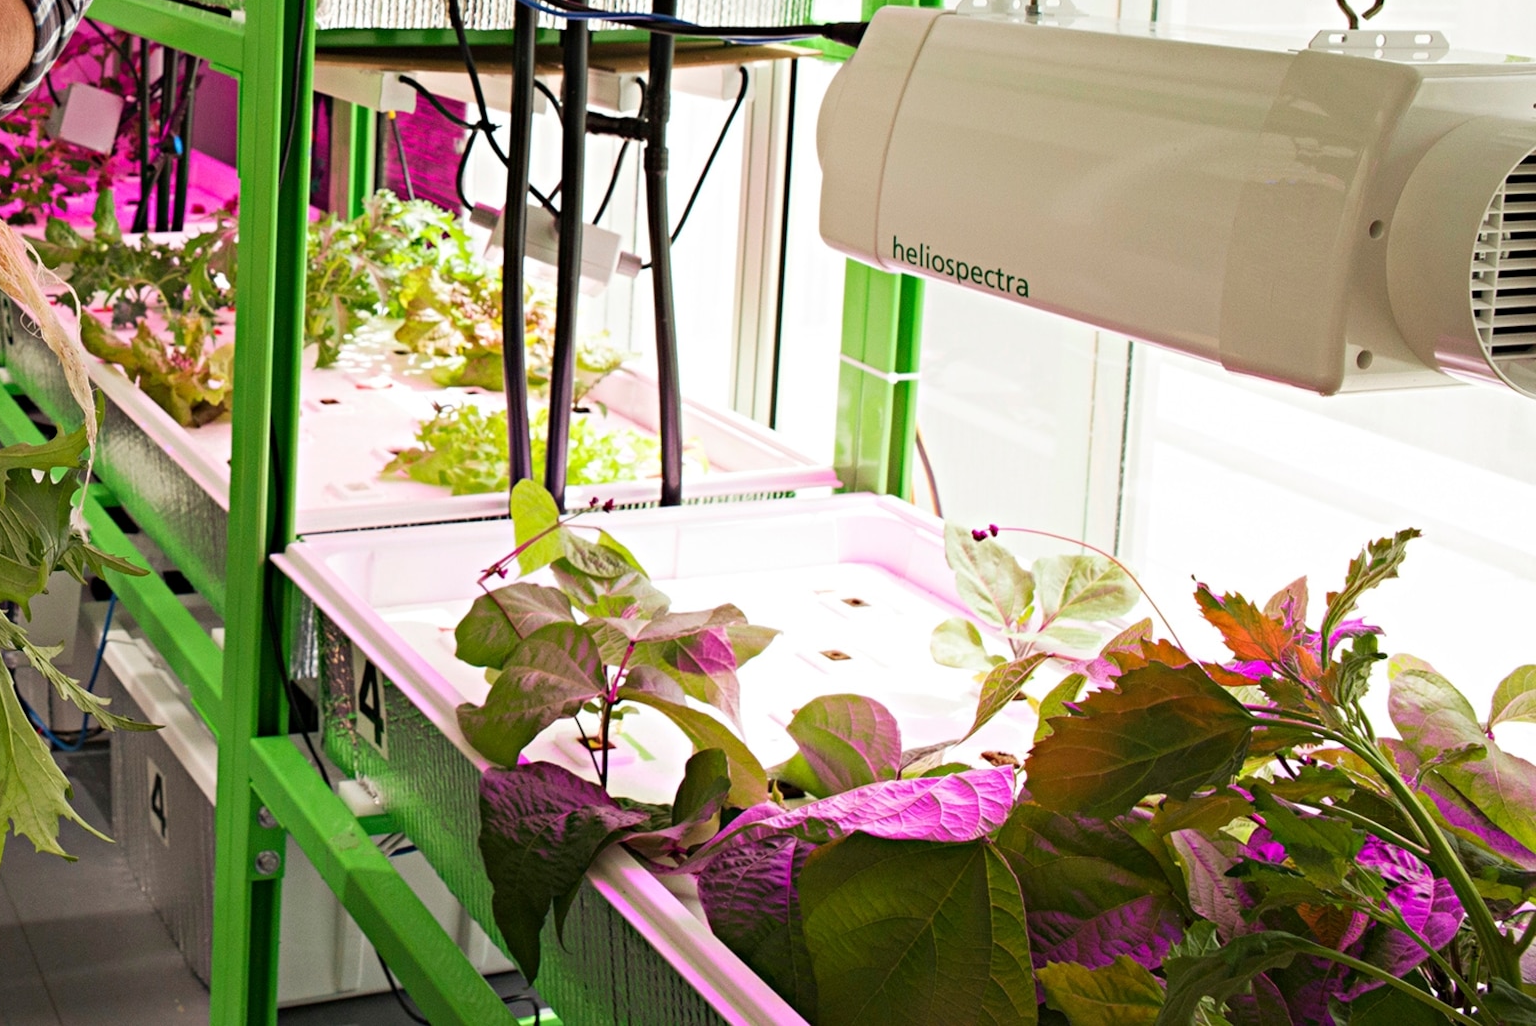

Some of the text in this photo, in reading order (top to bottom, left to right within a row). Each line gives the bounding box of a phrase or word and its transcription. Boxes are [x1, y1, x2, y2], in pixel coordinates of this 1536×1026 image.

[893, 235, 1029, 298] heliospectra
[358, 659, 384, 748] 4
[151, 773, 166, 839] 4
